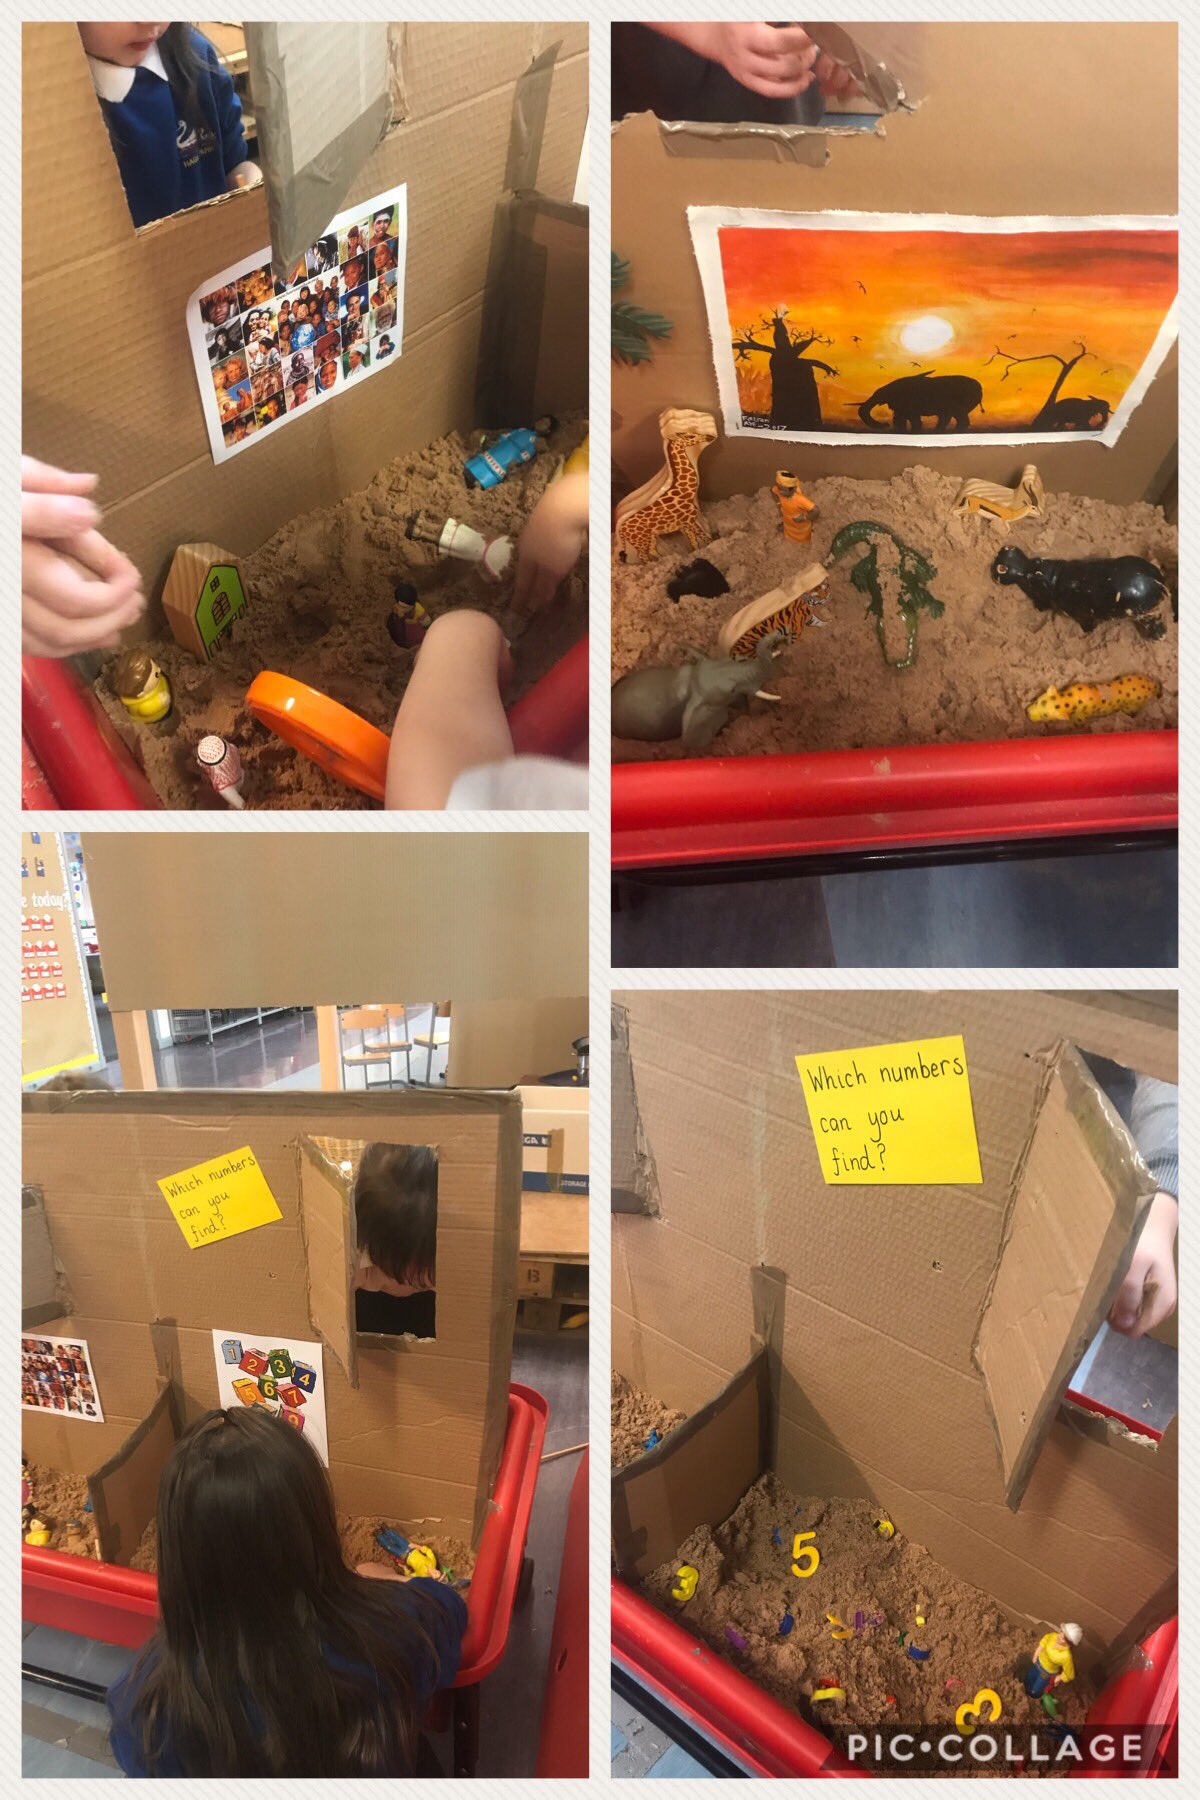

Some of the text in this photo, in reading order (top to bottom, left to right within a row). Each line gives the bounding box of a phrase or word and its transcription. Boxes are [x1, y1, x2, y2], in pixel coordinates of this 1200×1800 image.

[806, 1051, 964, 1093] Which numbers
[820, 1108, 904, 1143] can you
[166, 1156, 256, 1198] Which numbers
[832, 1142, 887, 1177] find?
[179, 1191, 230, 1221] can you
[190, 1213, 227, 1243] find?
[527, 1269, 540, 1283] B
[229, 1349, 310, 1386] 1 2 3 4
[245, 1381, 298, 1404] 5 6 7
[790, 1531, 821, 1578] 5
